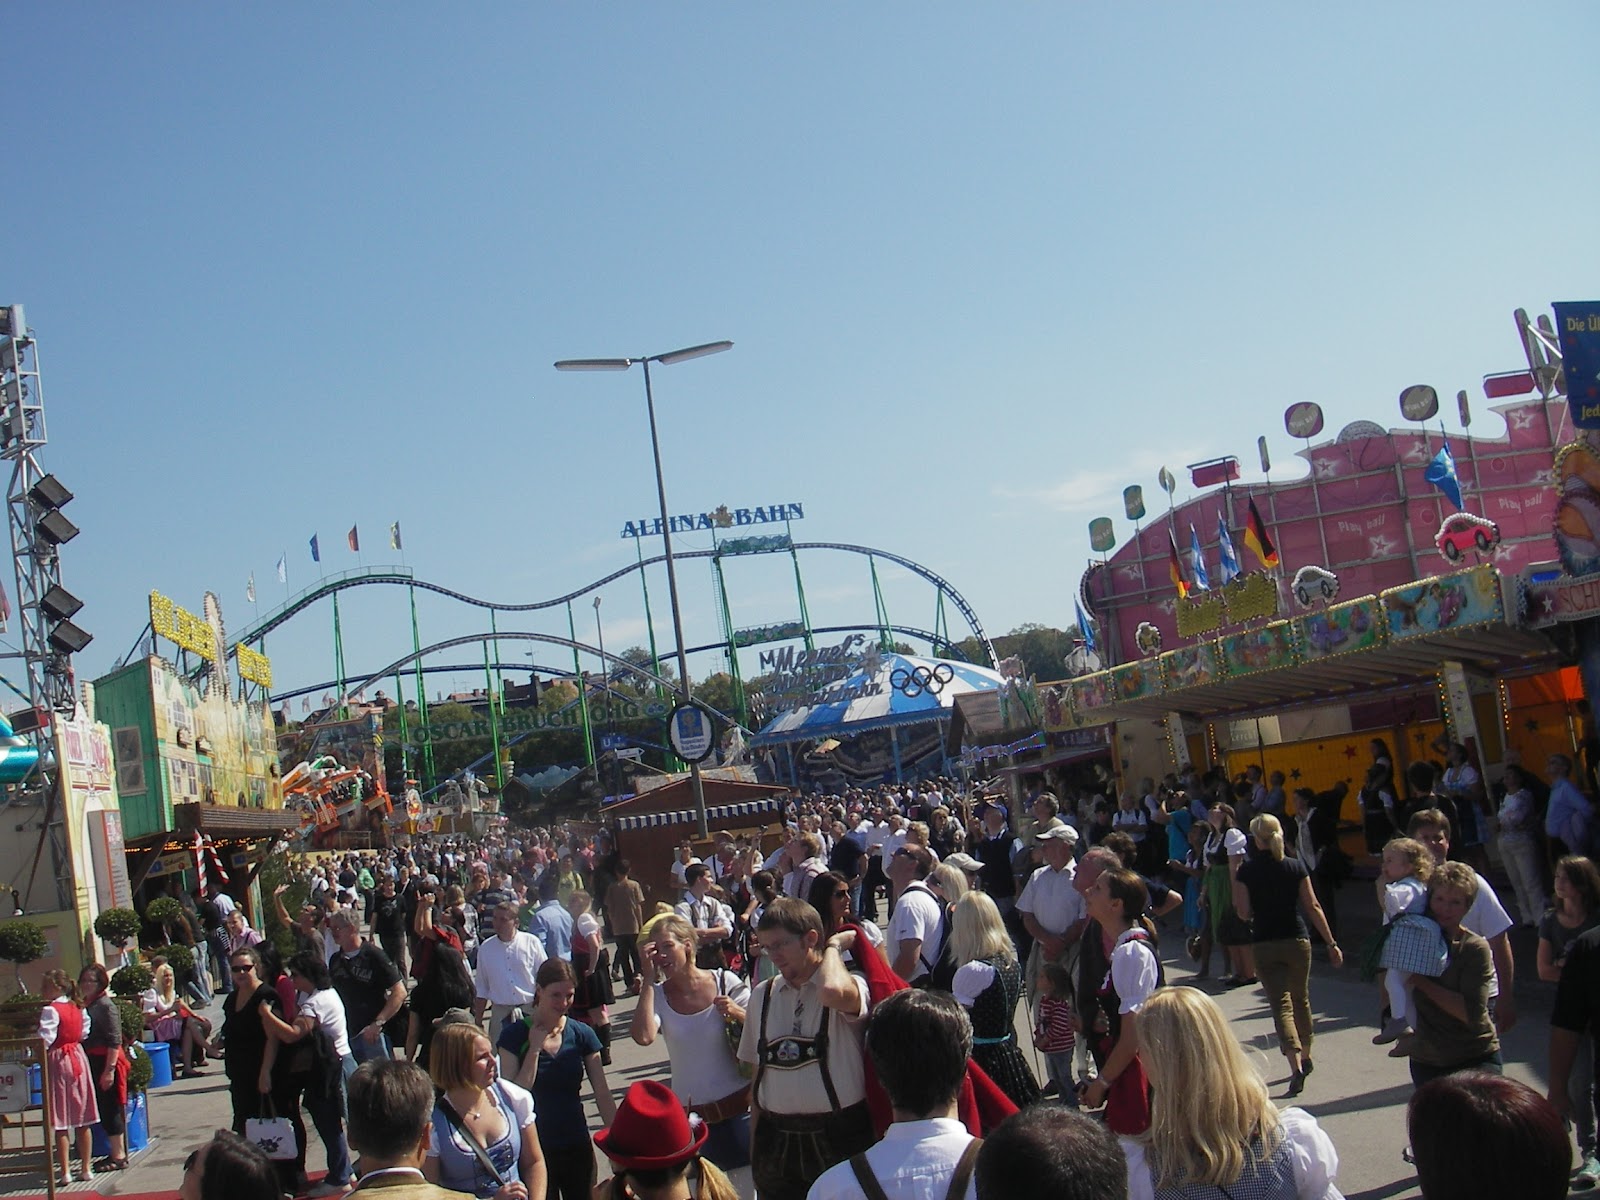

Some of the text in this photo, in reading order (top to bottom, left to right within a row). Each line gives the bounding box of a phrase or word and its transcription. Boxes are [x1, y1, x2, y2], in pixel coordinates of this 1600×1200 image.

[1567, 317, 1585, 332] Die
[735, 502, 804, 526] BAHN
[1498, 497, 1522, 514] Play
[1337, 520, 1362, 537] Play
[413, 701, 638, 743] OSCAR BRUCH OHG
[602, 738, 611, 748] U
